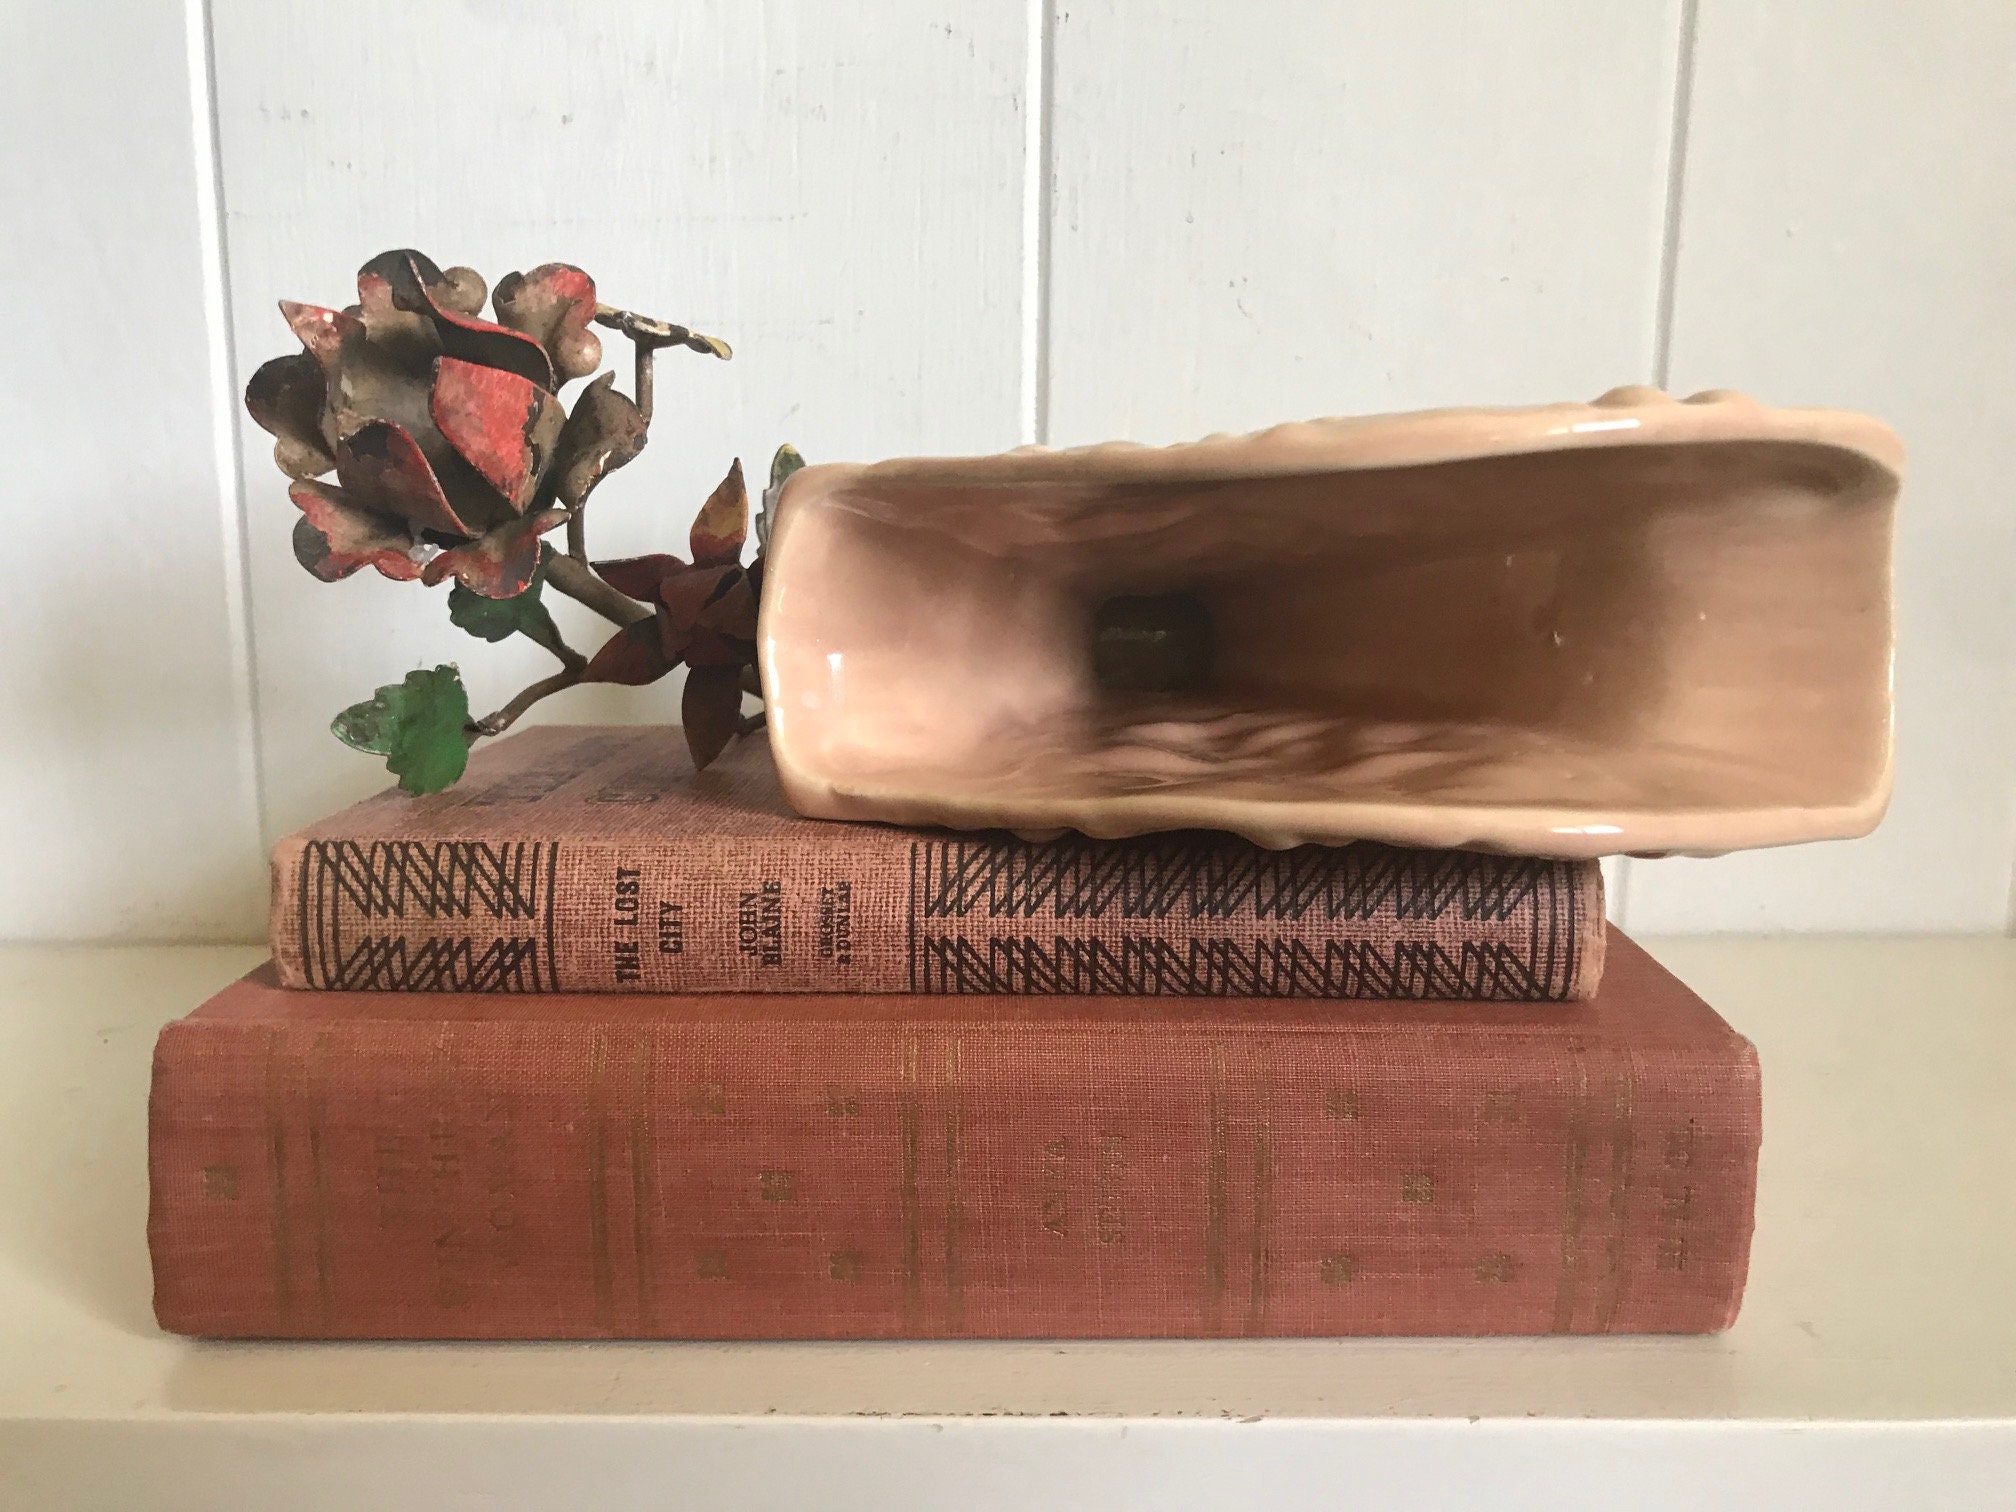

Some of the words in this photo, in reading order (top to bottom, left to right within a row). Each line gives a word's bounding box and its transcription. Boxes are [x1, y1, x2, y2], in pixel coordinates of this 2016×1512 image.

[614, 866, 642, 926] LOST
[739, 892, 758, 957] JOHN
[761, 880, 782, 965] BLAINE
[658, 900, 684, 953] CITY
[614, 940, 642, 984] THE
